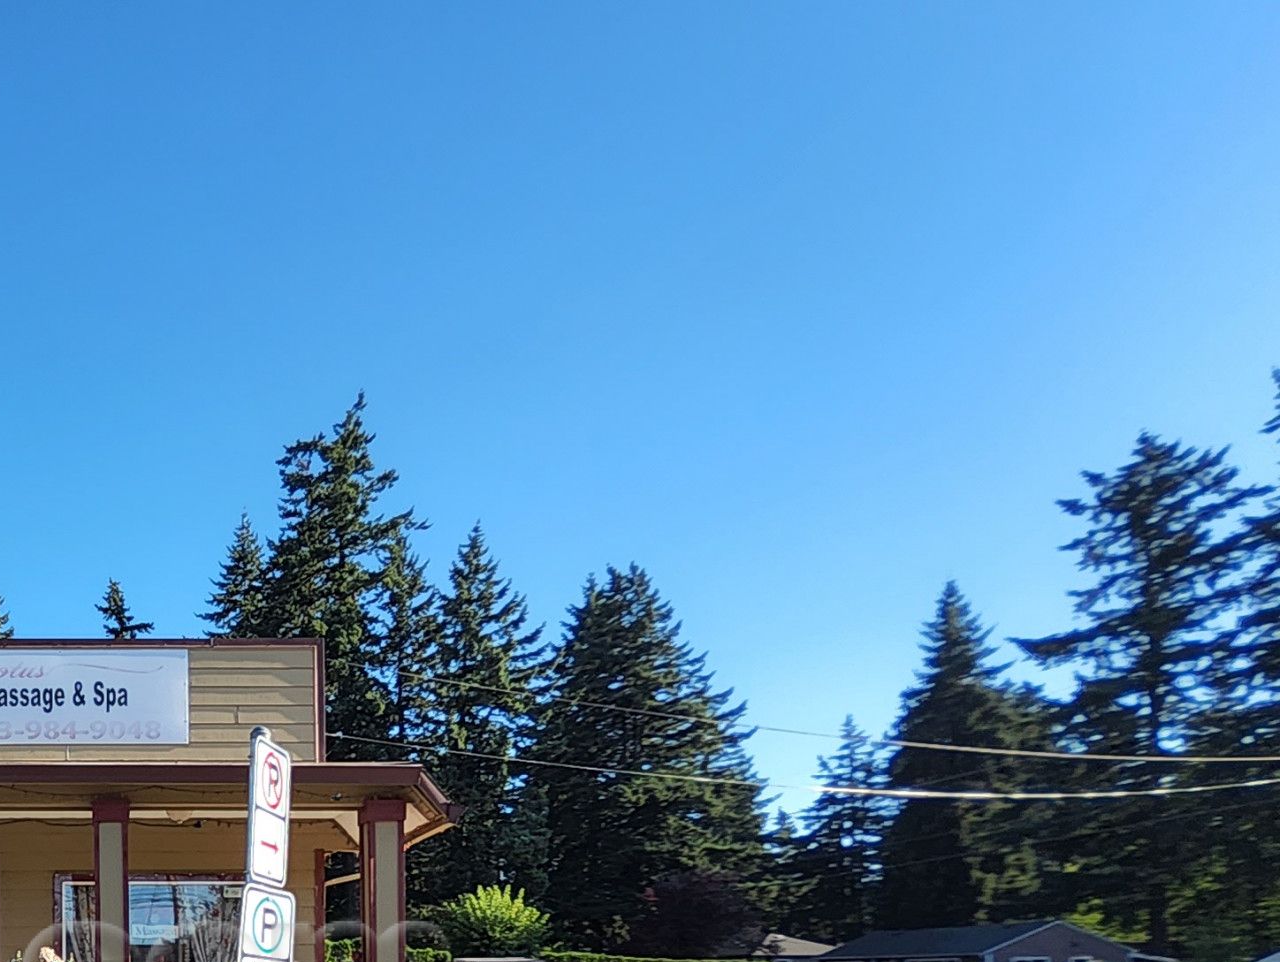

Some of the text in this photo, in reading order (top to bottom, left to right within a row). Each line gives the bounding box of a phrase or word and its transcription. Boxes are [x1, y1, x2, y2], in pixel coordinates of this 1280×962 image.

[72, 680, 86, 708] &
[93, 681, 129, 713] Spa
[260, 907, 278, 943] P
